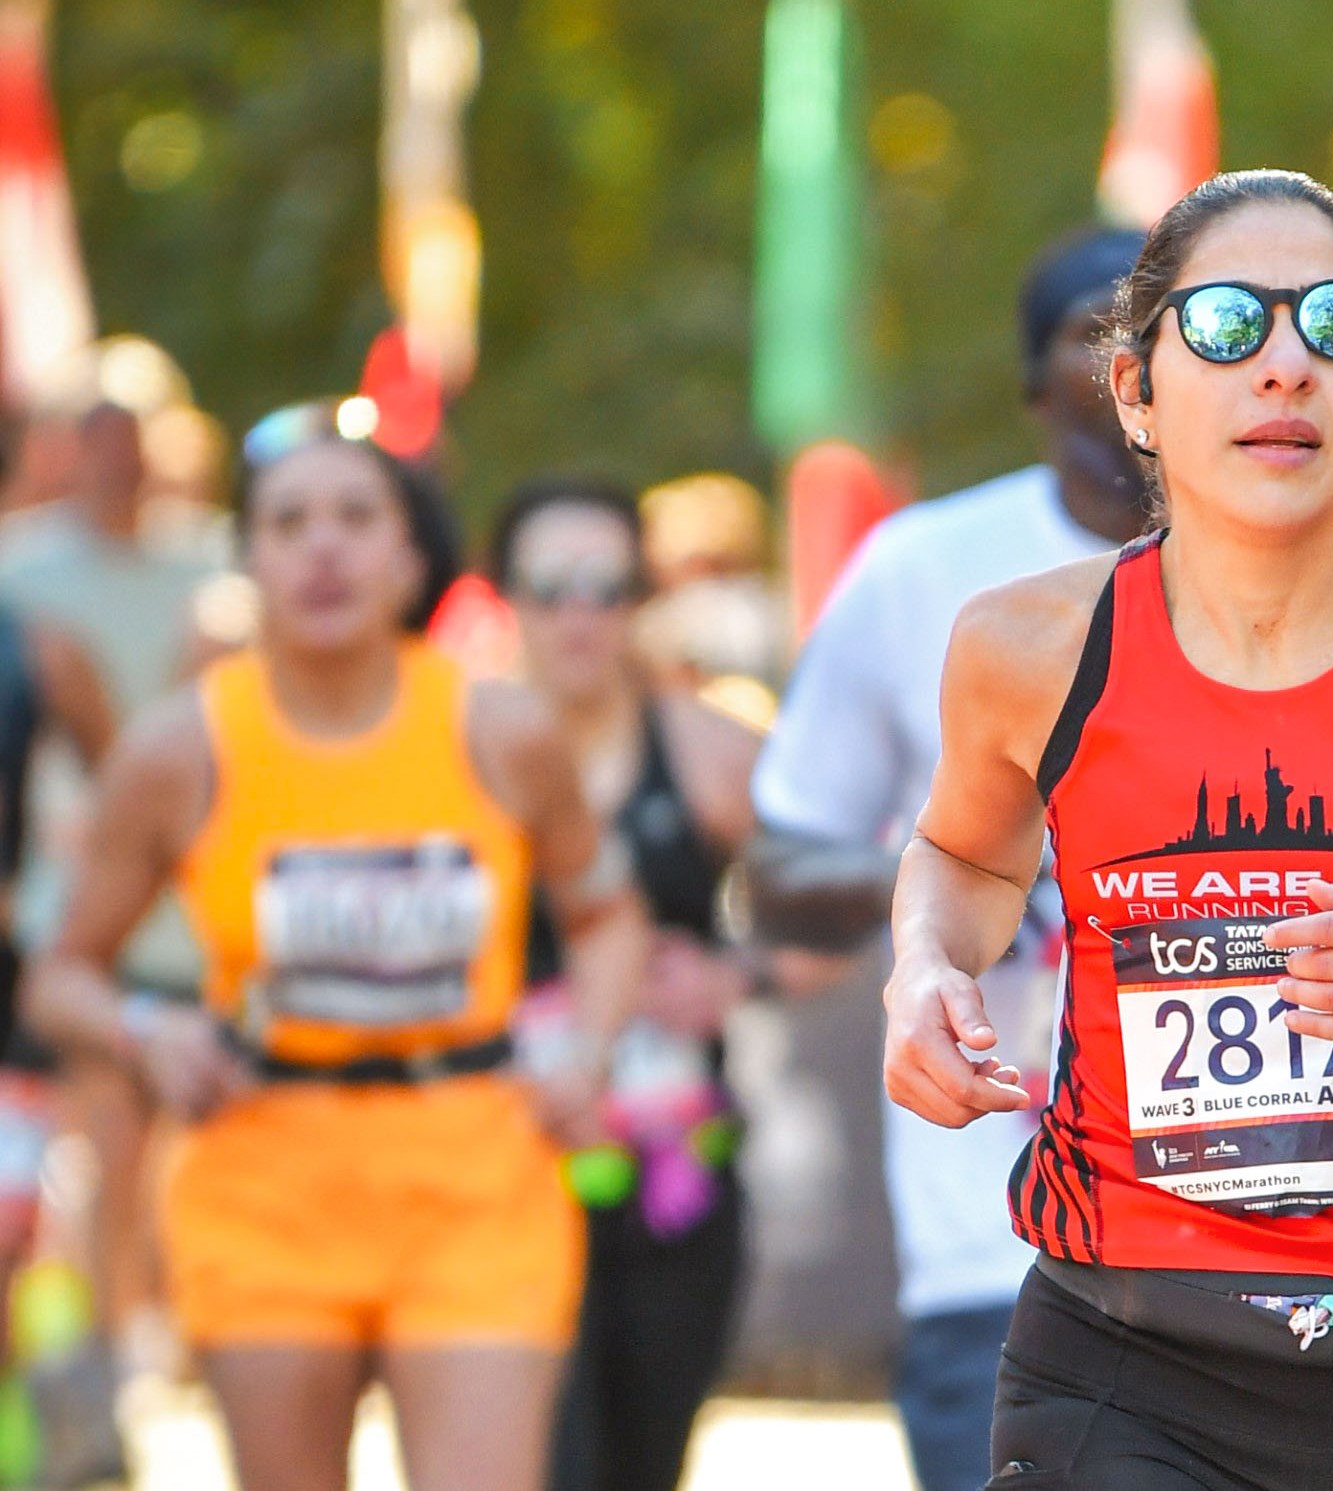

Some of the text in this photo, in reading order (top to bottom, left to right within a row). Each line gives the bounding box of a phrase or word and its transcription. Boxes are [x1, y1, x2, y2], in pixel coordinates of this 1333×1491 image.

[1091, 871, 1178, 898] WE
[1190, 870, 1321, 898] ARE
[1127, 901, 1309, 920] RUNNING
[1149, 931, 1218, 975] tcs
[1141, 1103, 1180, 1118] WAVE
[1182, 1097, 1195, 1117] 3
[1204, 1096, 1244, 1112] BLUE
[1247, 1091, 1313, 1107] CORRAL
[1171, 1174, 1302, 1195] #TCSNYCMarathon
